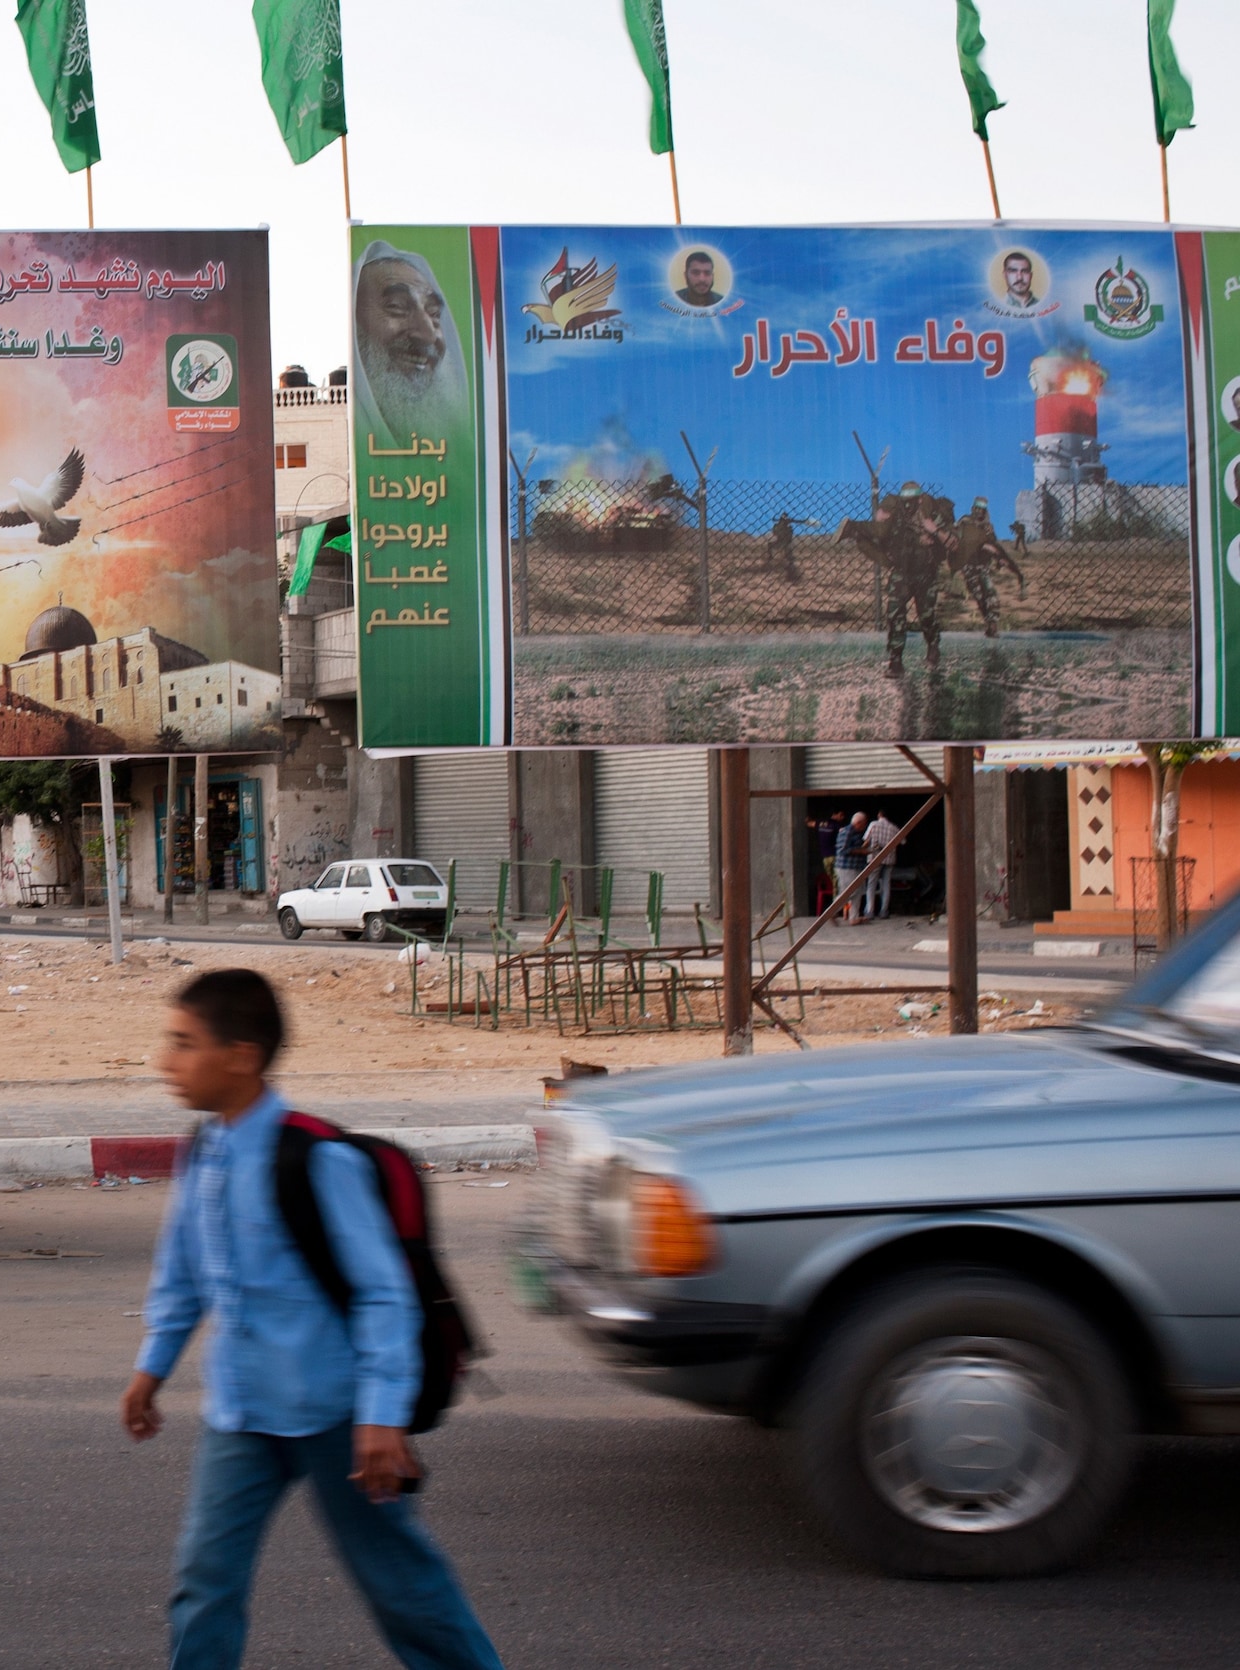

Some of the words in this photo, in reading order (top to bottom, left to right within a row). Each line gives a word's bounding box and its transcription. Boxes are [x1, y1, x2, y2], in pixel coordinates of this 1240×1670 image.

[58, 257, 142, 299] نشهد
[146, 261, 226, 300] اليوم
[45, 325, 123, 365] وغدا
[733, 308, 877, 378] الأحرار
[894, 318, 1006, 378] وفاء
[367, 431, 447, 462] بدنا
[368, 474, 446, 506] اولادنا
[362, 518, 448, 548] يروحوا
[366, 602, 450, 635] عنهم
